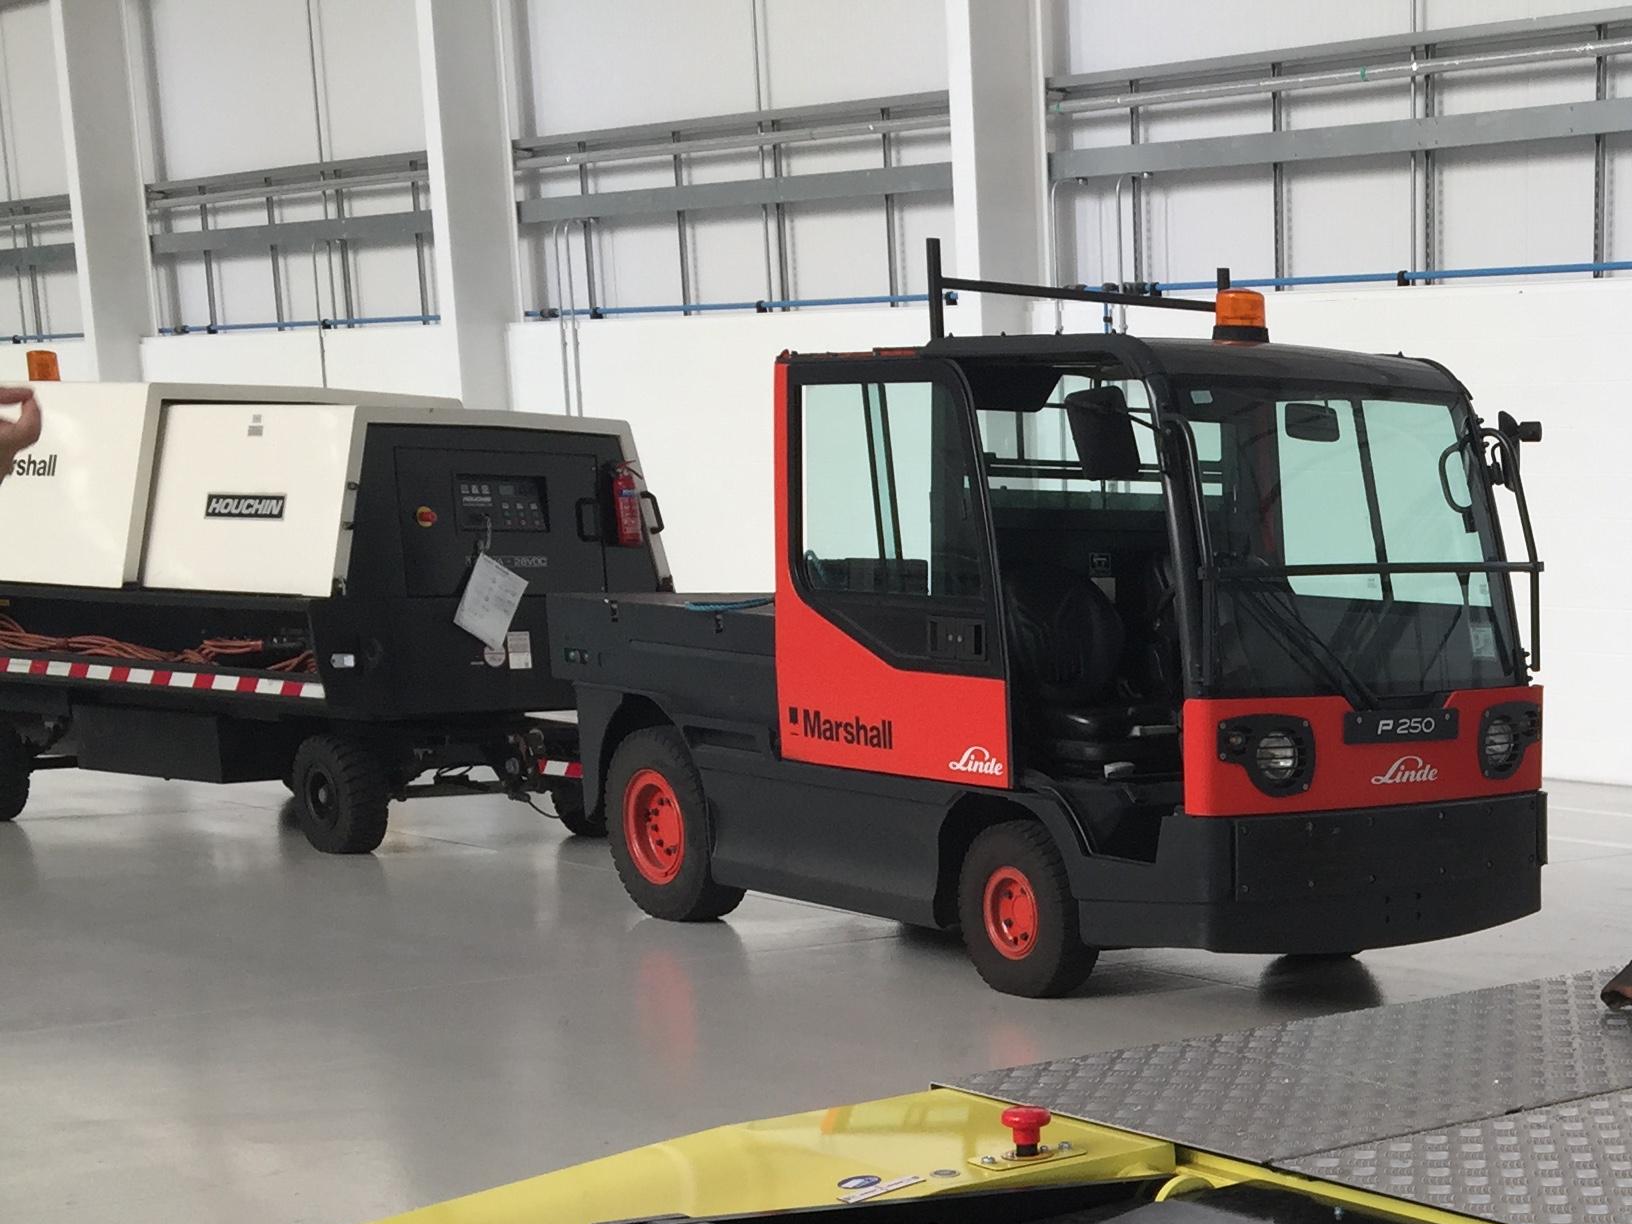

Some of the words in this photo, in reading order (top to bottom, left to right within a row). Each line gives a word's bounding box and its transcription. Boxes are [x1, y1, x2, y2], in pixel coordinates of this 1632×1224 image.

[13, 453, 58, 477] shall
[207, 498, 283, 515] HOUCHIN
[803, 709, 893, 749] Marshall
[1377, 719, 1394, 735] P
[1396, 717, 1435, 734] 250
[948, 746, 1003, 775] Linde
[1370, 755, 1439, 785] Linde
